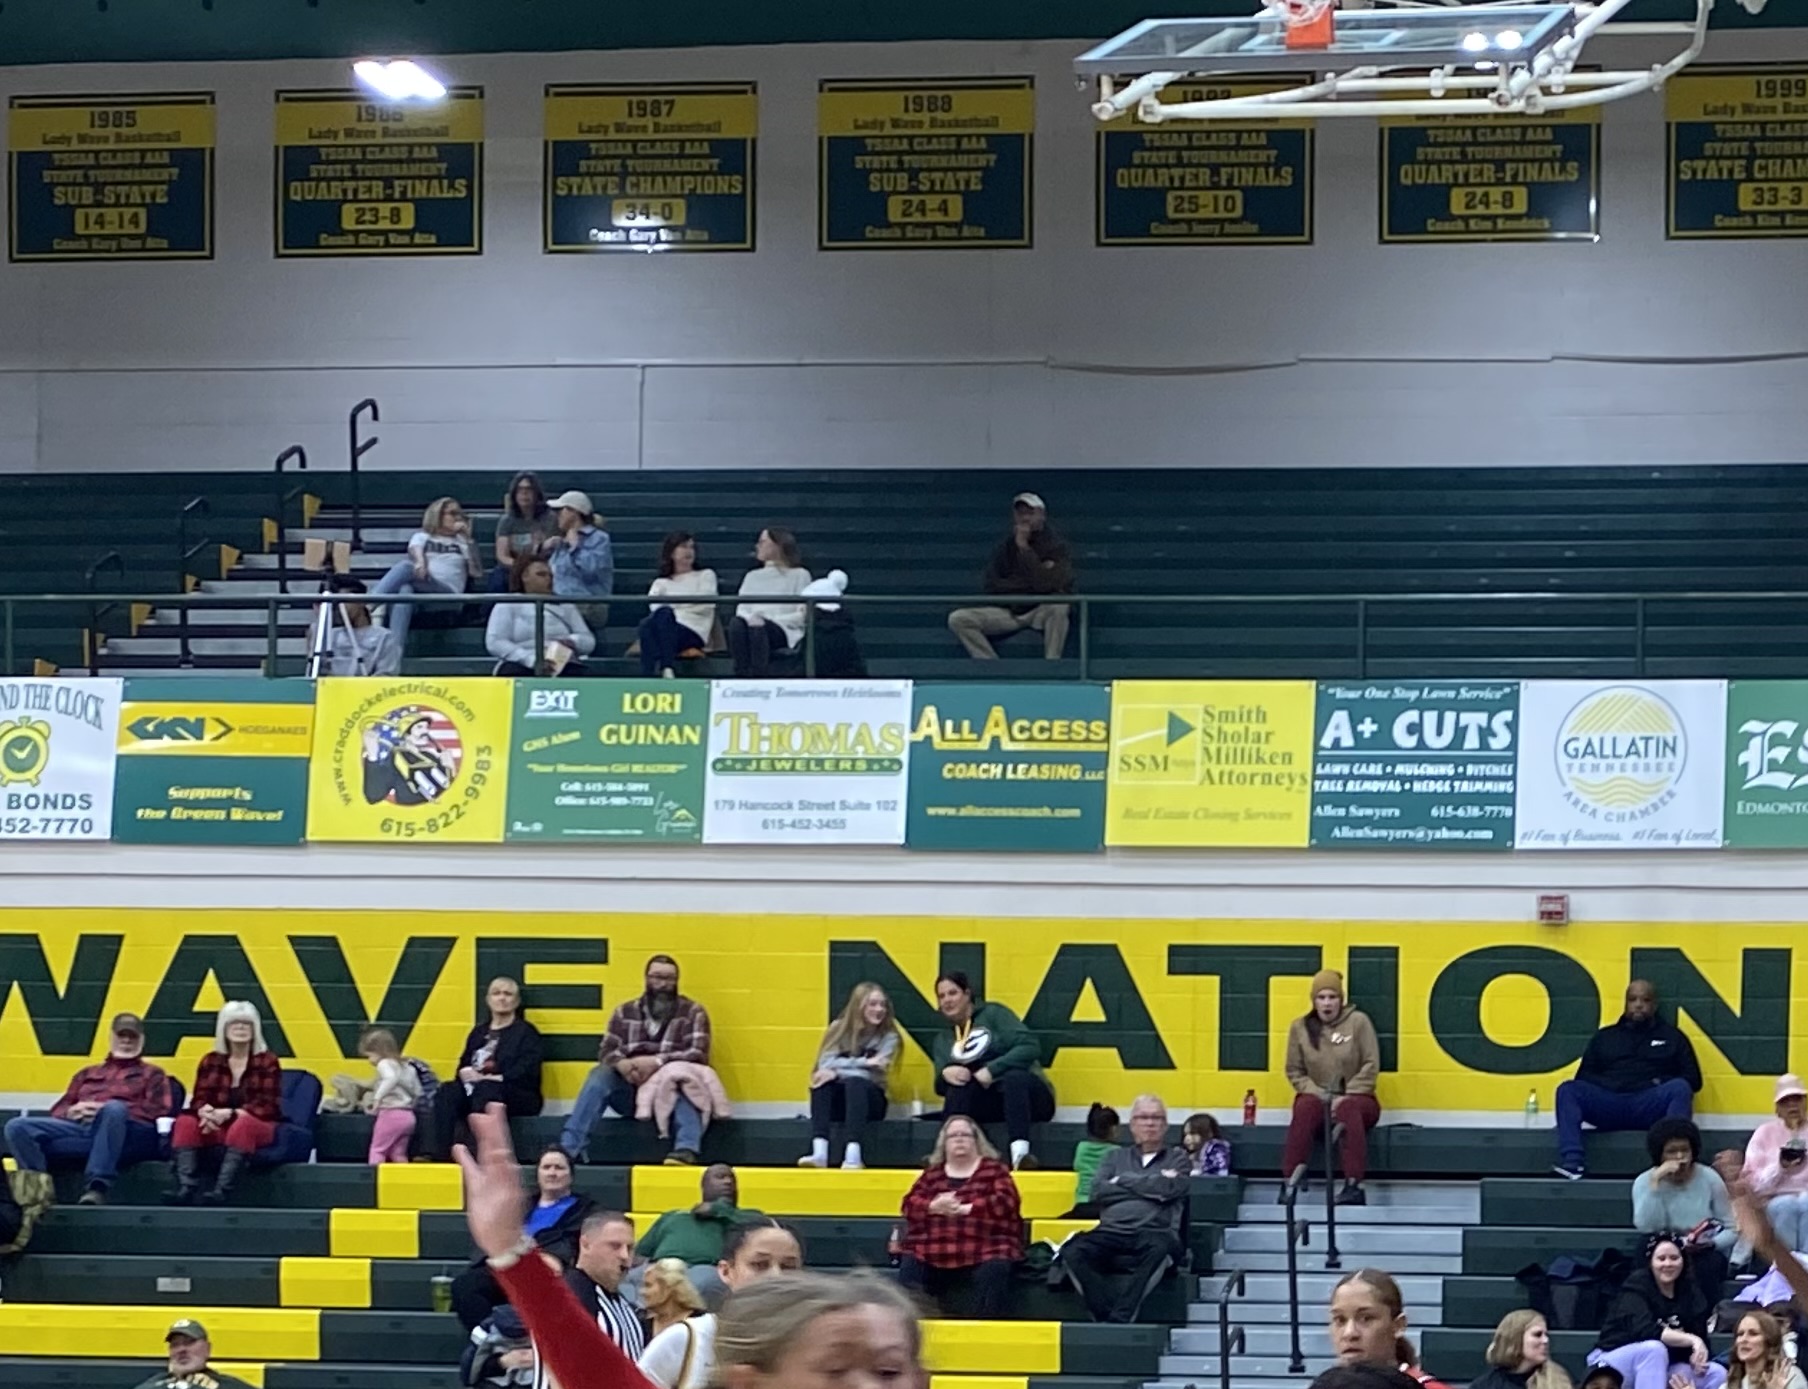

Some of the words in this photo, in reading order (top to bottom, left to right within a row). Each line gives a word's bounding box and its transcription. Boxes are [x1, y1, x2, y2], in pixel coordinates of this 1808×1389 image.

[1756, 79, 1807, 98] 1999
[627, 99, 676, 118] 1987
[904, 95, 952, 113] 1988
[90, 111, 137, 128] 1985
[1116, 167, 1293, 188] QUARTER-FINALS
[1400, 162, 1579, 185] QUARTER-FINALS
[1679, 159, 1747, 180] STATE
[289, 179, 468, 200] QUARTER-FINALS
[555, 176, 620, 196] STATE
[626, 175, 743, 195] CHAMPIONS
[869, 171, 983, 192] SUB-STATE
[53, 185, 169, 205] SUB-STATE
[1173, 195, 1236, 214] 25-10
[1464, 191, 1514, 210] 24-8
[1752, 187, 1803, 206] 33-3
[354, 206, 402, 225] 23-8
[625, 202, 673, 221] 34-0
[901, 199, 949, 217] 24-4
[83, 211, 141, 230] 14-14
[530, 690, 579, 711] EXIT
[1422, 687, 1456, 699] Lawn
[23, 683, 53, 711] THE
[55, 686, 105, 730] CLOCK
[622, 693, 682, 714] LORI
[1203, 705, 1267, 724] Smith
[599, 724, 701, 745] GUINAN
[714, 712, 905, 756] THOMAS
[980, 705, 1107, 748] ACCESS
[1202, 725, 1274, 745] Sholar
[1319, 710, 1379, 749] A+
[1392, 709, 1514, 750] CUTS
[332, 681, 475, 806] www.craddockelectrical.com
[1563, 736, 1677, 759] GALLATIN
[746, 759, 867, 771] JEWELERS
[1119, 755, 1169, 772] SSM
[1200, 746, 1293, 765] Milliken
[942, 762, 1003, 779] COACH
[1566, 763, 1675, 773] TENNESSEE
[1199, 768, 1308, 791] Attorneys
[7, 794, 93, 810] BONDS
[168, 786, 252, 800] Supports
[136, 808, 166, 820] the
[170, 807, 226, 820] Green
[714, 799, 735, 811] 179
[738, 799, 794, 811] Hancock
[798, 799, 836, 811] Street
[839, 799, 872, 811] Suite
[1563, 791, 1598, 819] AREA
[1604, 788, 1677, 823] CHAMBER
[828, 939, 1792, 1076] NATION
